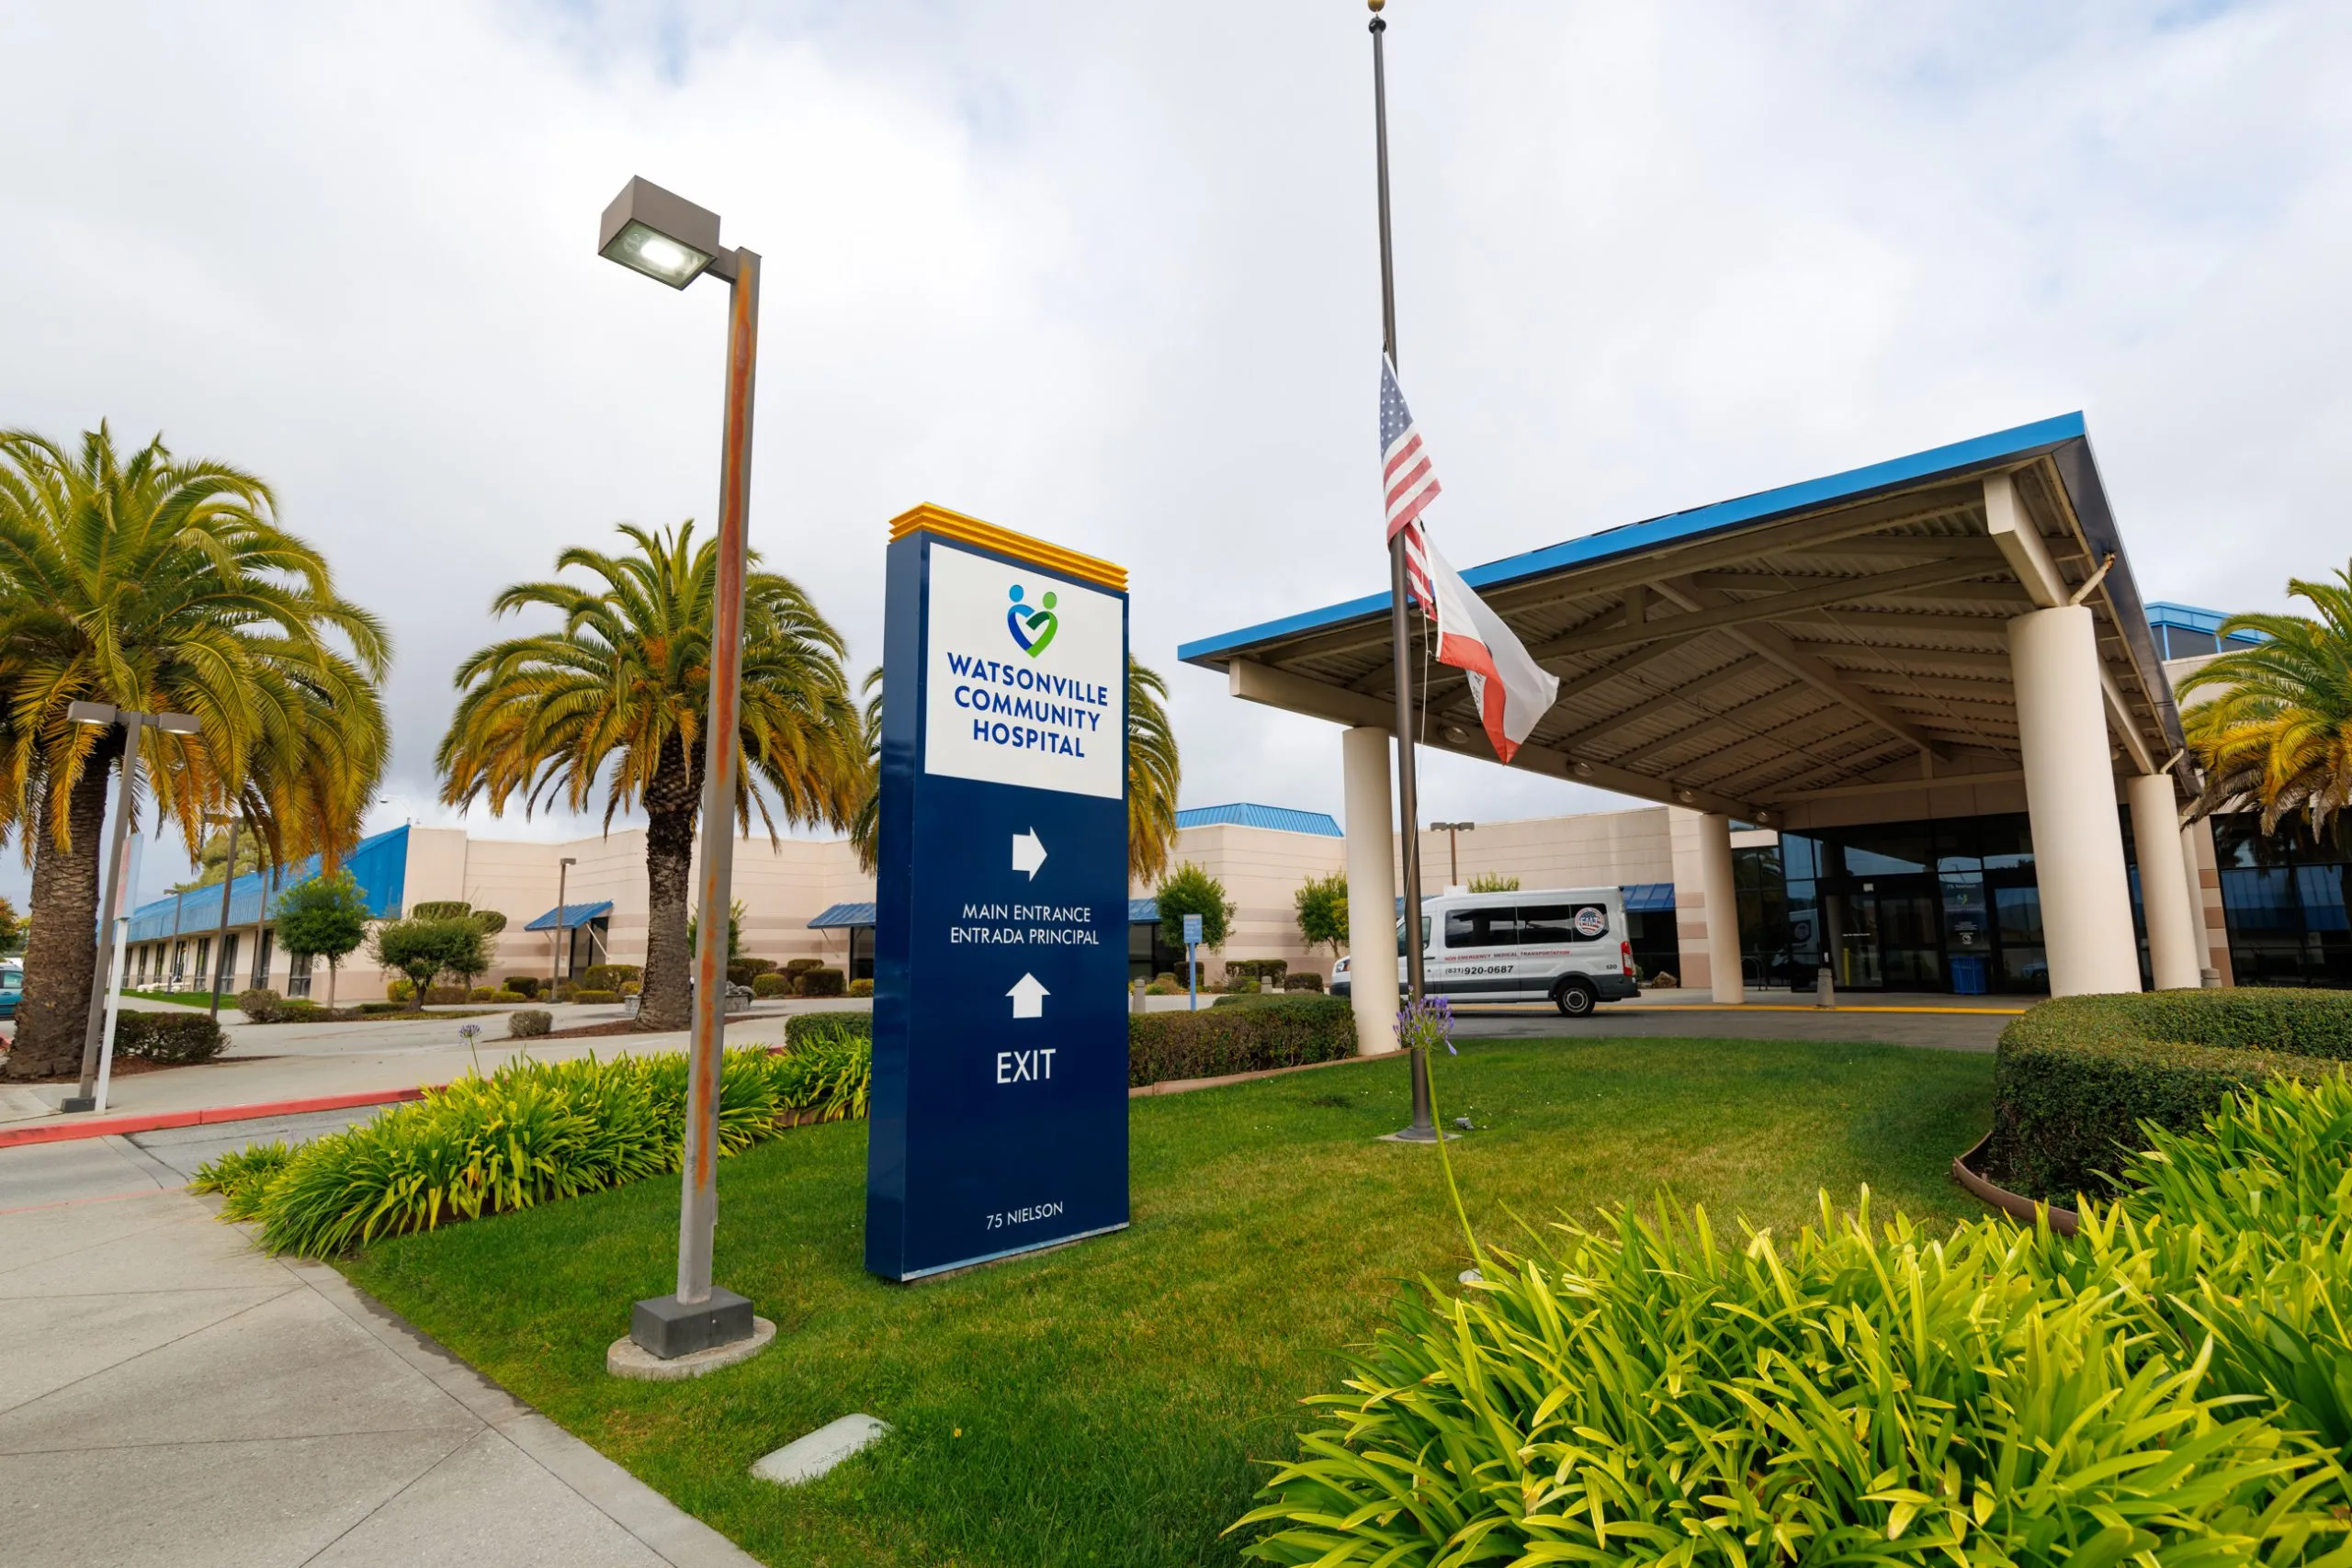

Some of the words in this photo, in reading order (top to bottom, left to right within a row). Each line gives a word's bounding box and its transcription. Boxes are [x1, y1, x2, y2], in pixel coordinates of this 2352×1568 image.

[947, 652, 1108, 706] WATSONVILLE
[955, 685, 1101, 732] COMMUNITY
[973, 719, 1085, 758] HOSPITAL
[963, 904, 1008, 919] MAIN
[1013, 905, 1091, 922] ENTRANCE
[951, 927, 1024, 944] ENTRADA
[1029, 929, 1099, 944] PRINCIPAL
[997, 1048, 1056, 1084] EXIT
[986, 1213, 1002, 1230] 75
[1007, 1201, 1063, 1225] NIELSON
